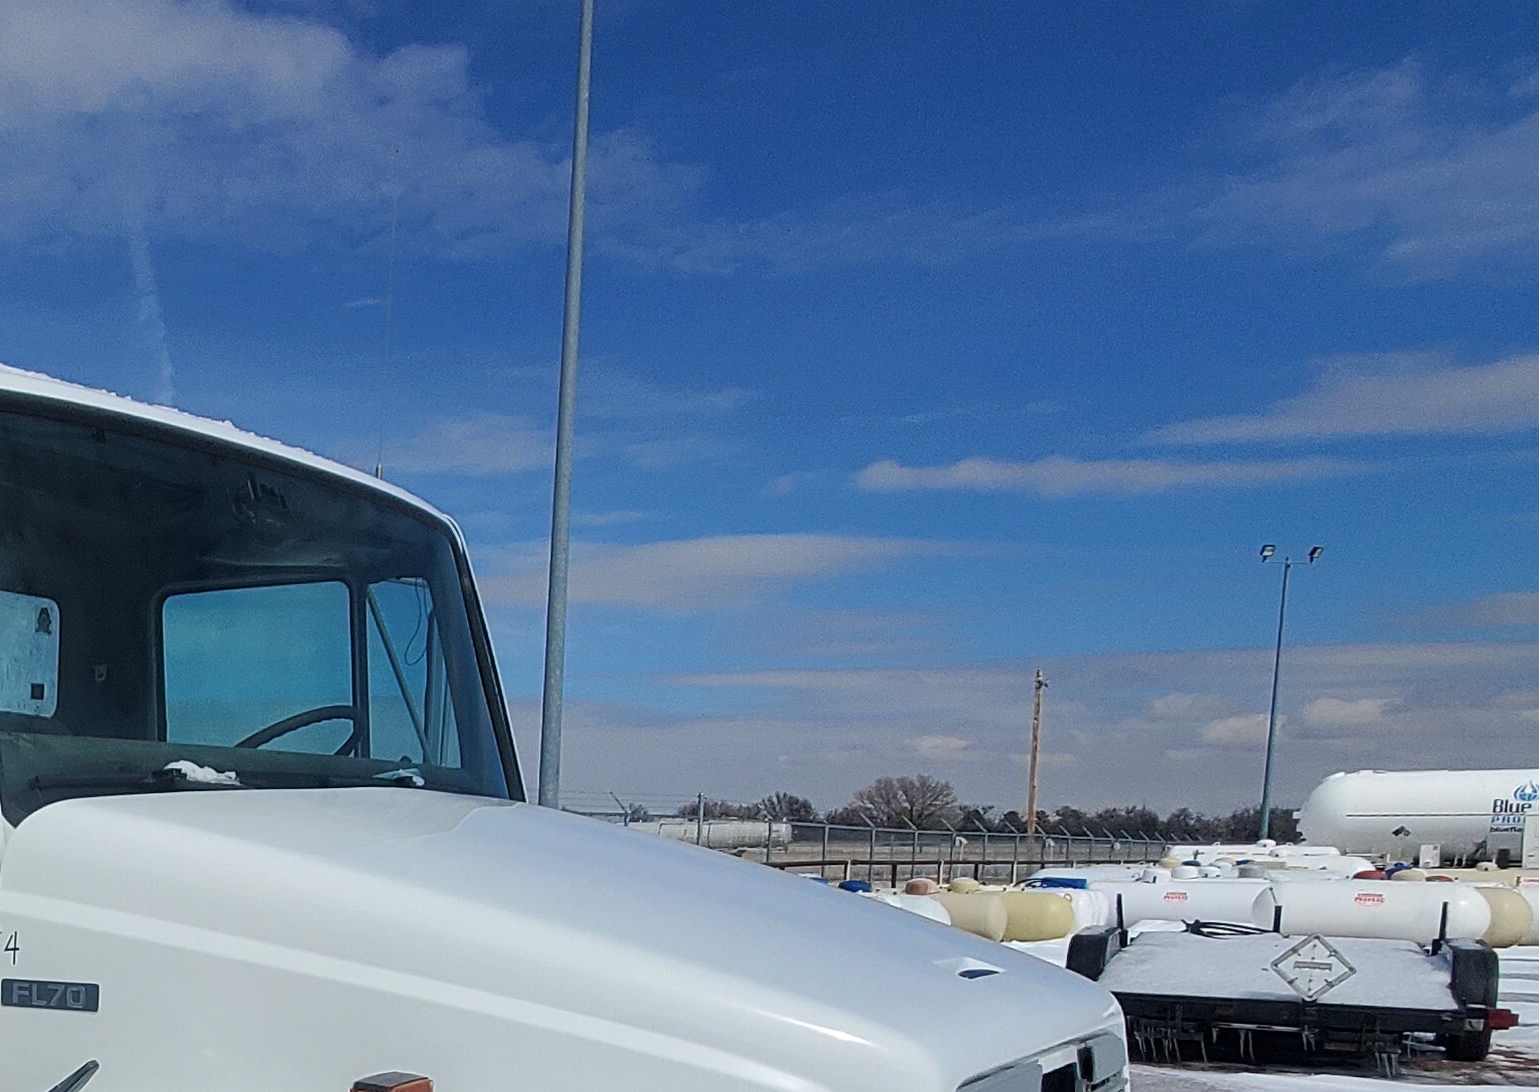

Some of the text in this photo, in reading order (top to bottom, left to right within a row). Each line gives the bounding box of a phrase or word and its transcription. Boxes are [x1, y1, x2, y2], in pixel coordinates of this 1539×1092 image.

[1492, 798, 1532, 813] Blue
[4, 930, 20, 965] 4
[12, 982, 86, 1008] FL70
